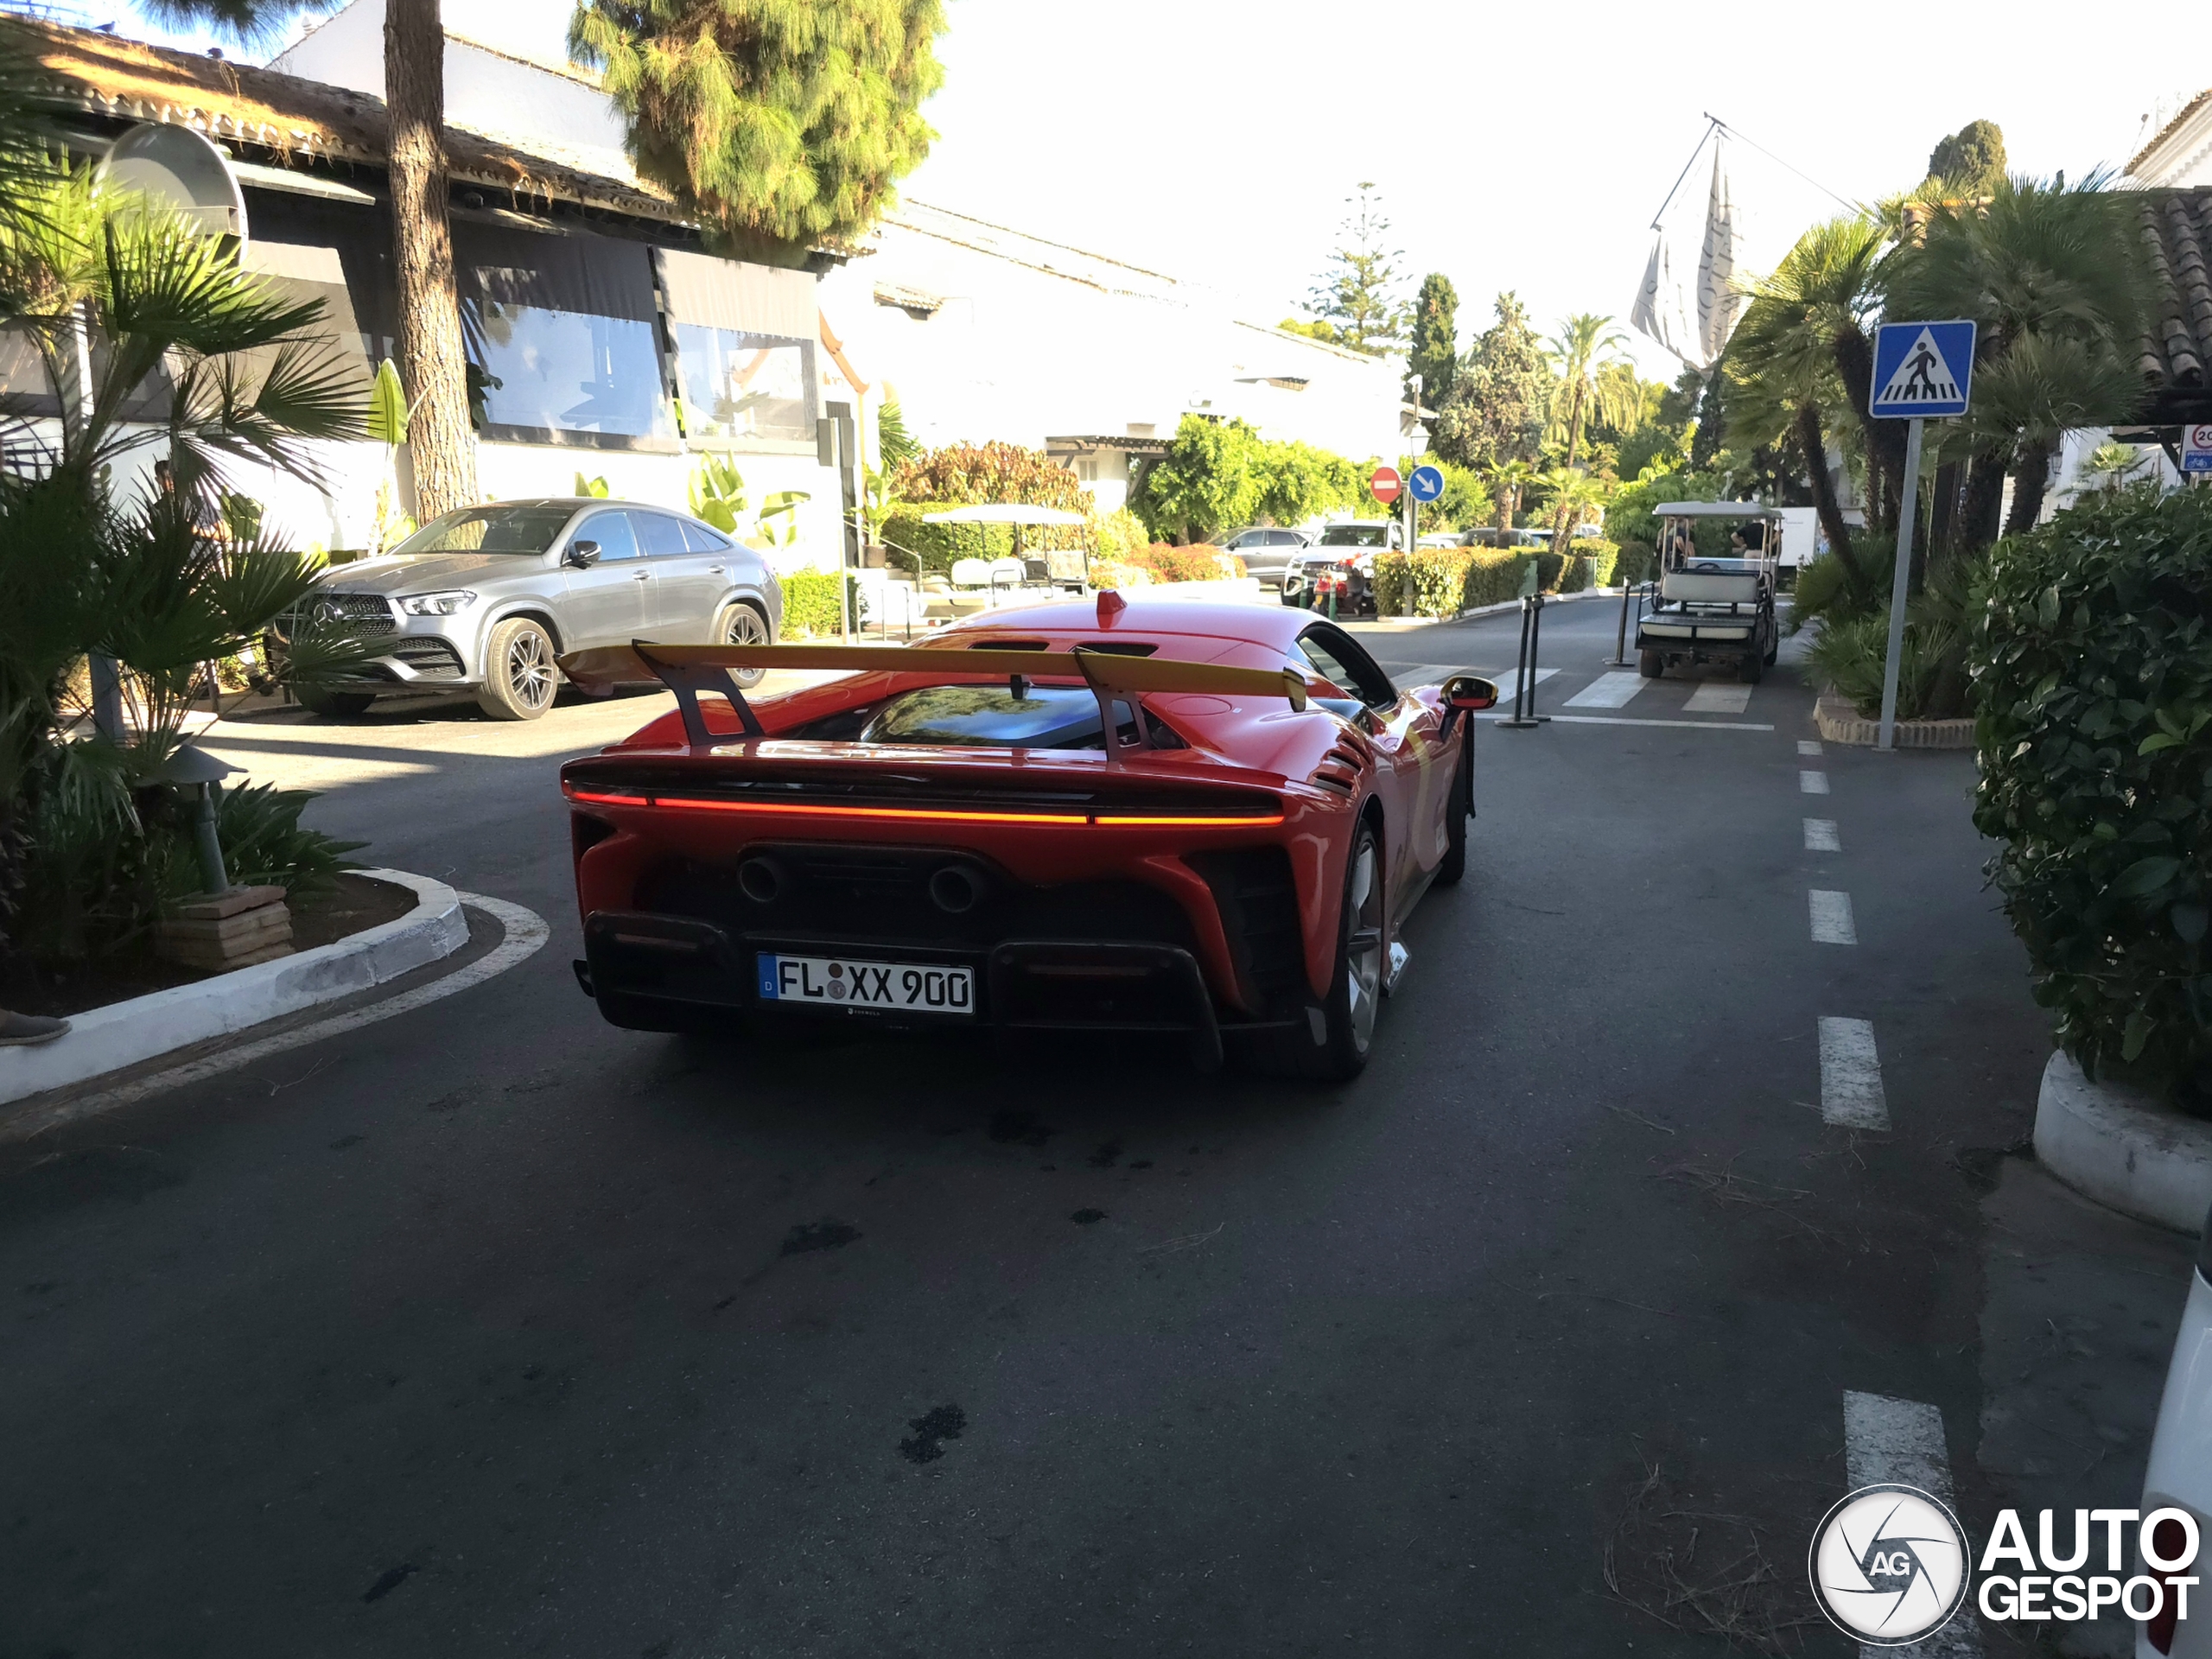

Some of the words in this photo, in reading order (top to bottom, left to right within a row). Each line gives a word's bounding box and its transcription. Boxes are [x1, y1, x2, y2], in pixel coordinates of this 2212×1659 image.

[765, 981, 772, 991] D
[779, 961, 823, 997] FL
[849, 966, 893, 1002] XX
[902, 970, 968, 1007] 900
